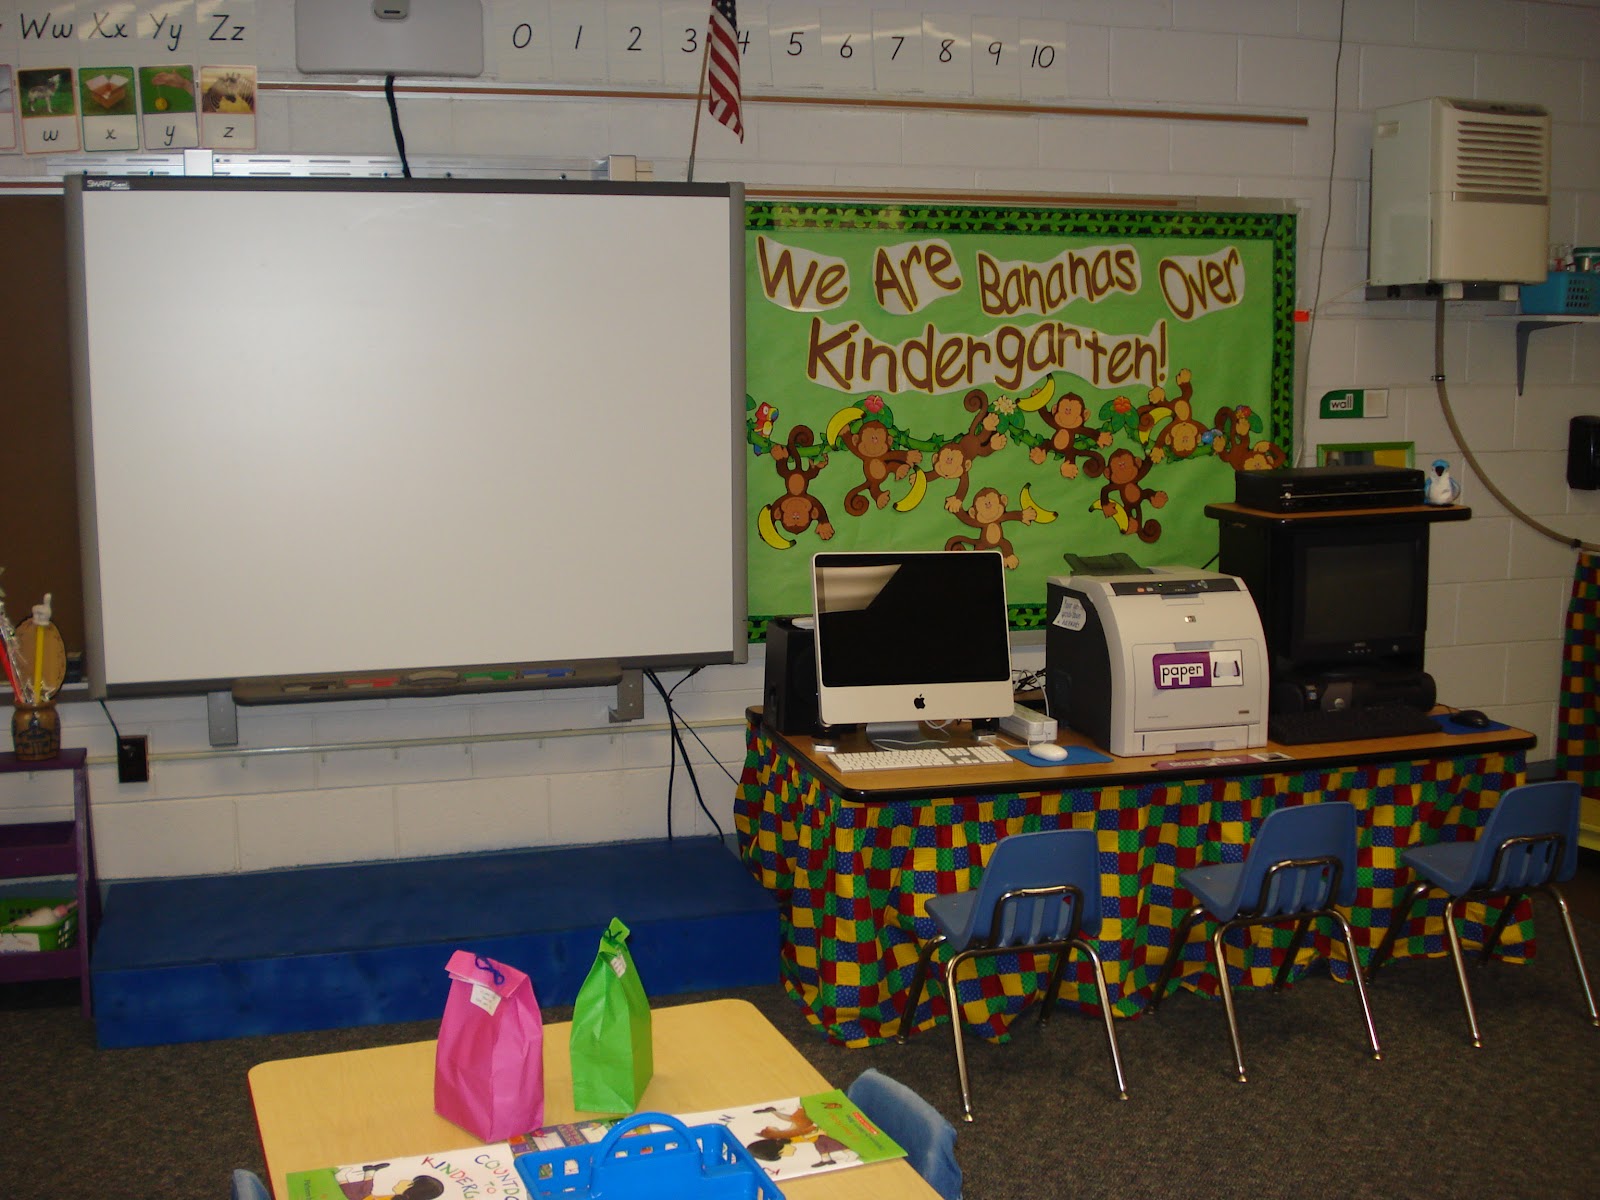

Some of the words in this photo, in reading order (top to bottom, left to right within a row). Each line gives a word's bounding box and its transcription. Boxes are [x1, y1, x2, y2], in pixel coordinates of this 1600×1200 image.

[20, 13, 73, 40] Ww
[88, 12, 128, 40] Xx
[150, 13, 182, 51] Yy
[208, 14, 245, 41] Zz
[513, 23, 532, 49] 0
[574, 25, 583, 50] 1
[627, 26, 643, 51] 2
[681, 28, 697, 53] 3
[786, 31, 805, 56] 5
[840, 34, 853, 59] 6
[891, 36, 905, 61] 7
[938, 39, 955, 63] 8
[988, 41, 1002, 66] 9
[1031, 45, 1055, 69] 10
[42, 128, 59, 142] w
[105, 128, 117, 140] x
[164, 124, 176, 147] y
[223, 126, 234, 139] z
[757, 235, 849, 309] We
[875, 244, 962, 312] Are
[978, 249, 1137, 316] Bananas
[1158, 247, 1239, 321] Over
[807, 316, 1167, 393] Kindergarten!
[1331, 395, 1352, 409] wall
[1161, 664, 1202, 684] paper
